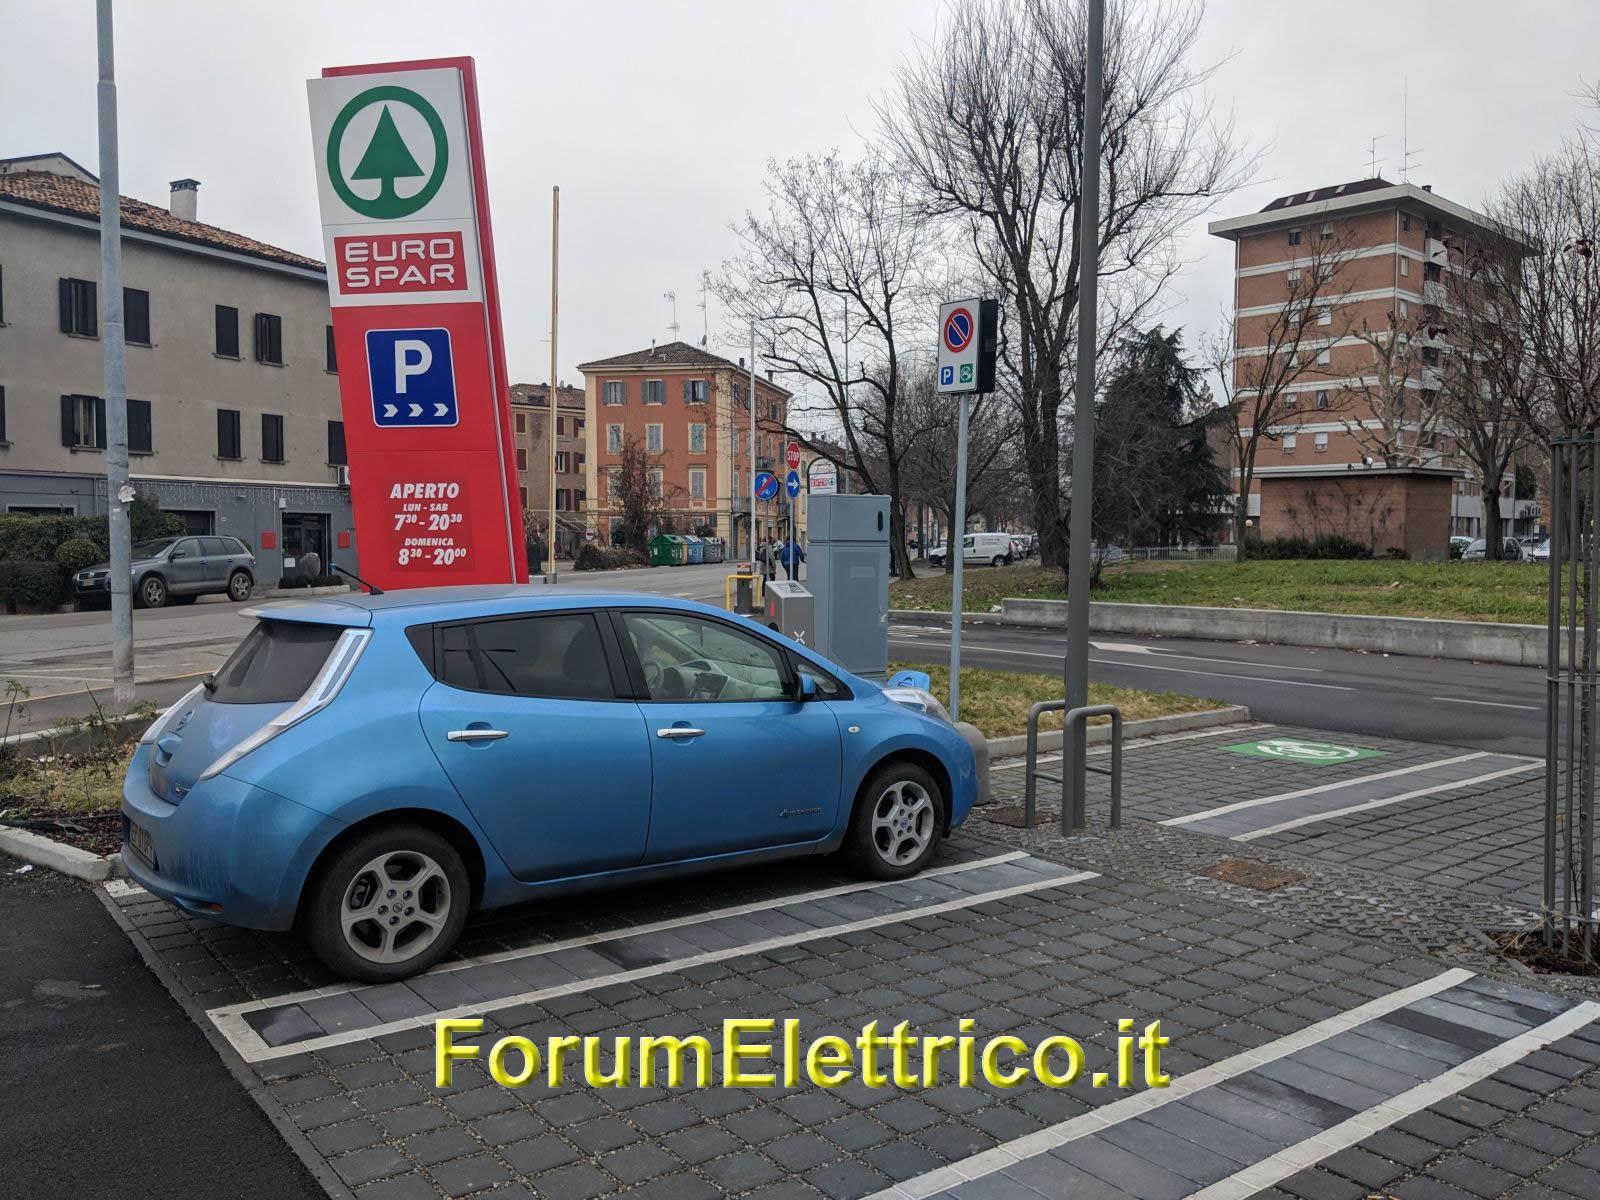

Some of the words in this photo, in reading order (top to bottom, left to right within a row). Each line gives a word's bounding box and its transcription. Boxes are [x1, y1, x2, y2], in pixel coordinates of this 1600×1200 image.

[345, 238, 455, 263] EURO
[346, 263, 455, 288] SPAR
[394, 339, 433, 394] P
[943, 368, 952, 383] P
[787, 450, 800, 462] STOP
[390, 482, 460, 499] APERTO
[403, 503, 422, 512] LUN
[429, 503, 449, 512] SAB
[404, 537, 454, 547] DOMENICA
